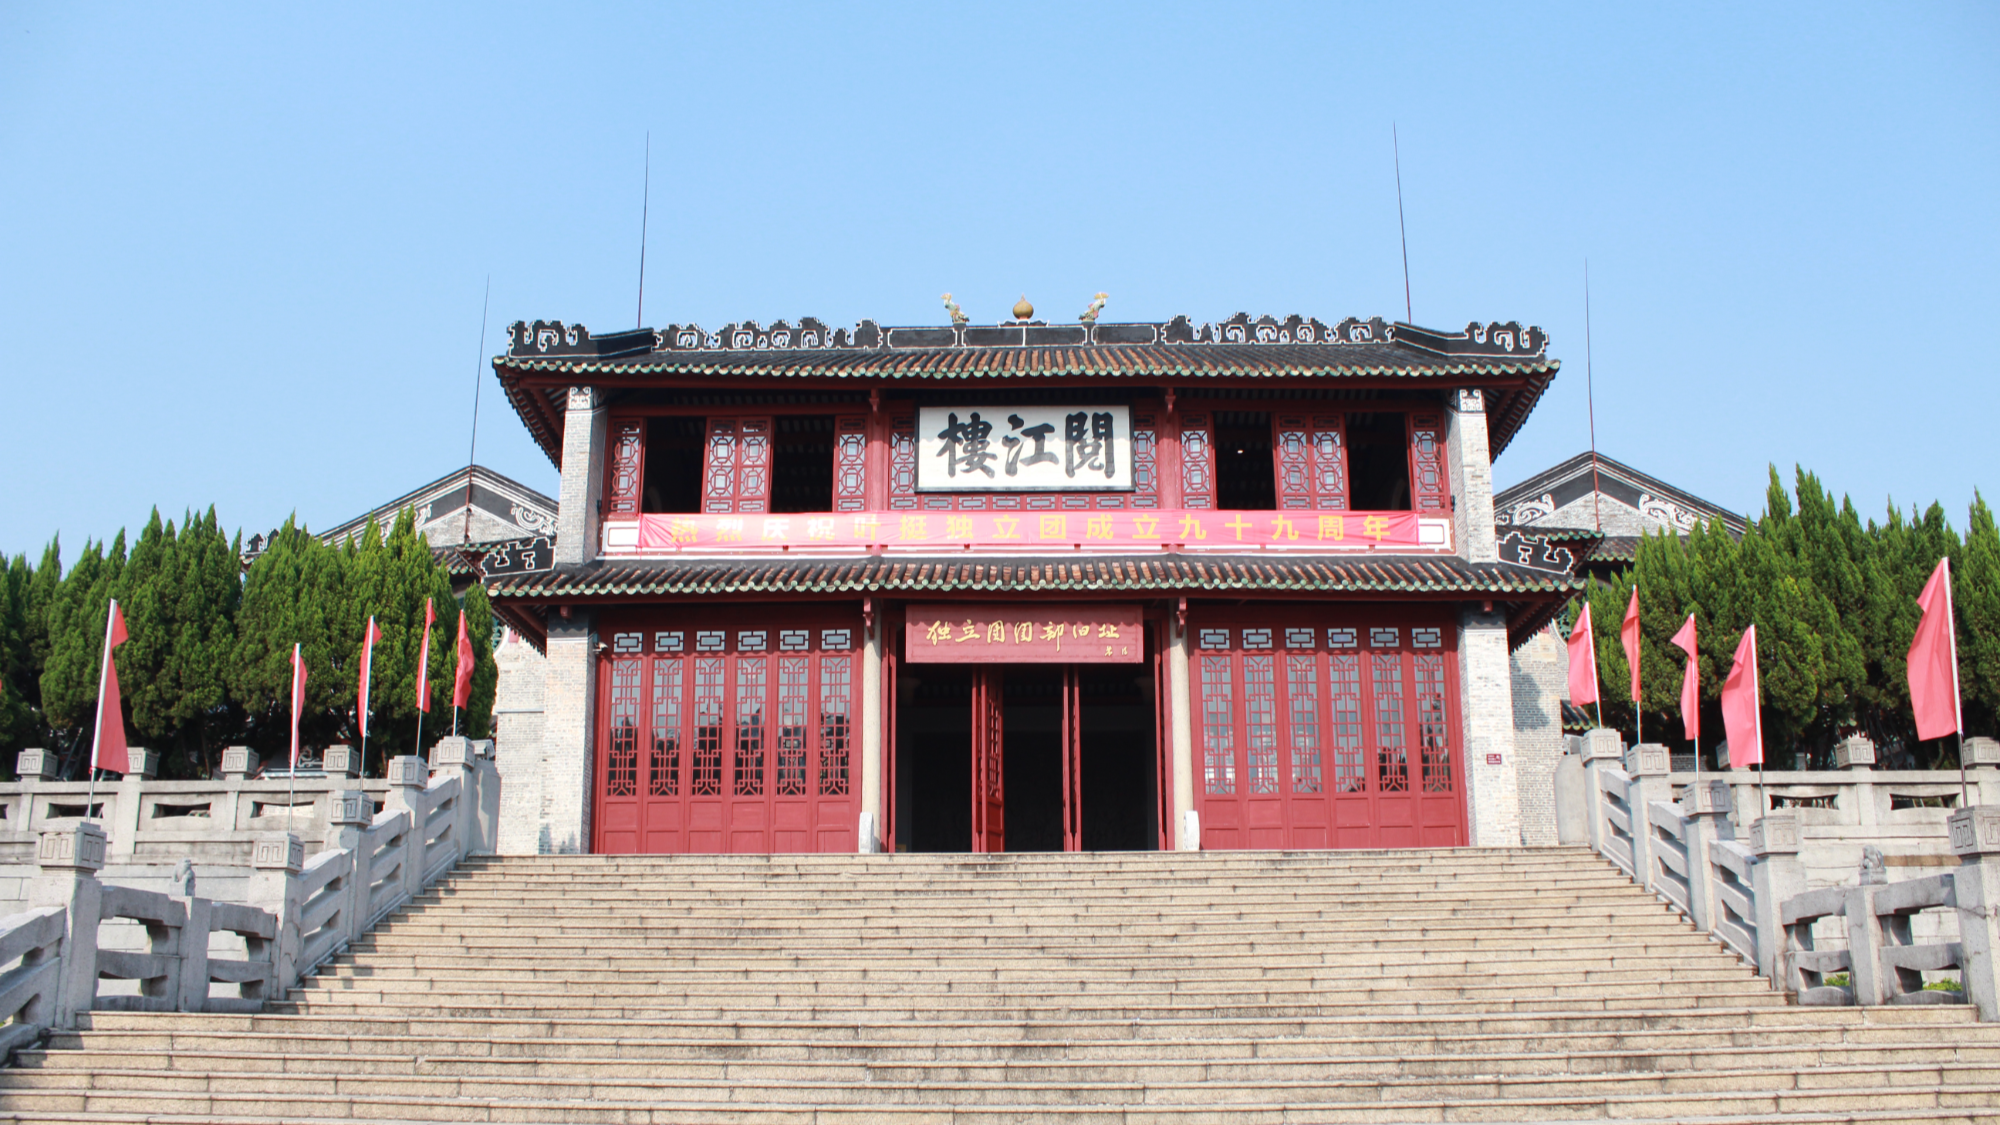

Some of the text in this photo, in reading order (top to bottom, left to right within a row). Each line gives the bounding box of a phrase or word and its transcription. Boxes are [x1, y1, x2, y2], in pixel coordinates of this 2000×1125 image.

[670, 512, 1391, 543] 热烈庆祝叶挺独立团成立九十九周年
